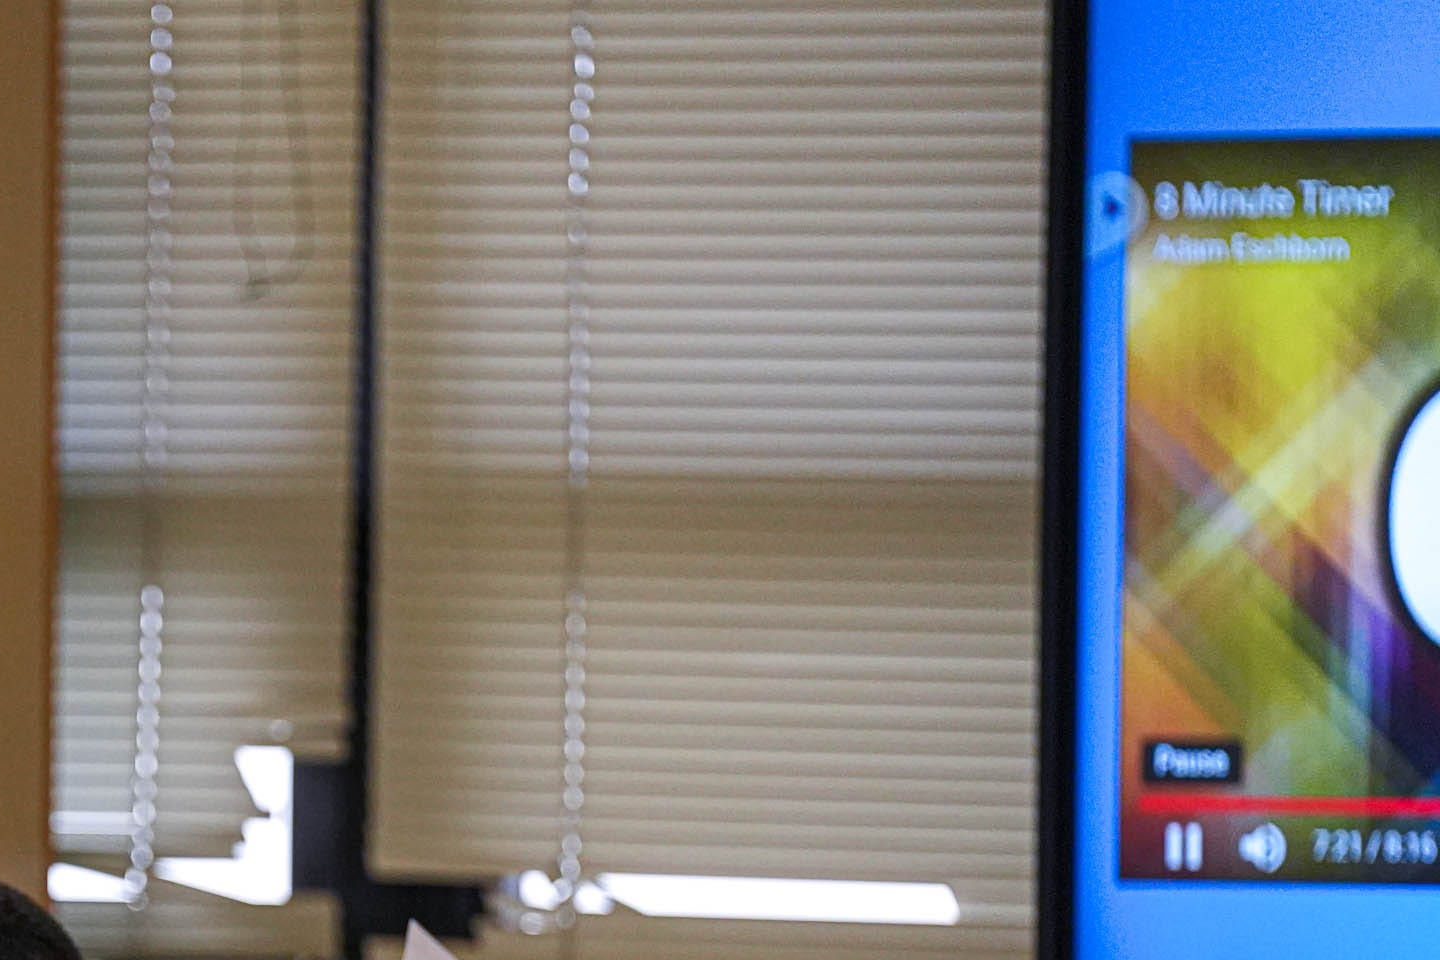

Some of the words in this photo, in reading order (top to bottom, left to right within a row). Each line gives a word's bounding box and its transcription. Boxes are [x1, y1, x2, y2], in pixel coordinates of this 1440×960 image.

[1182, 180, 1294, 218] Minute
[1298, 179, 1394, 217] Timer
[1154, 743, 1229, 778] Pause
